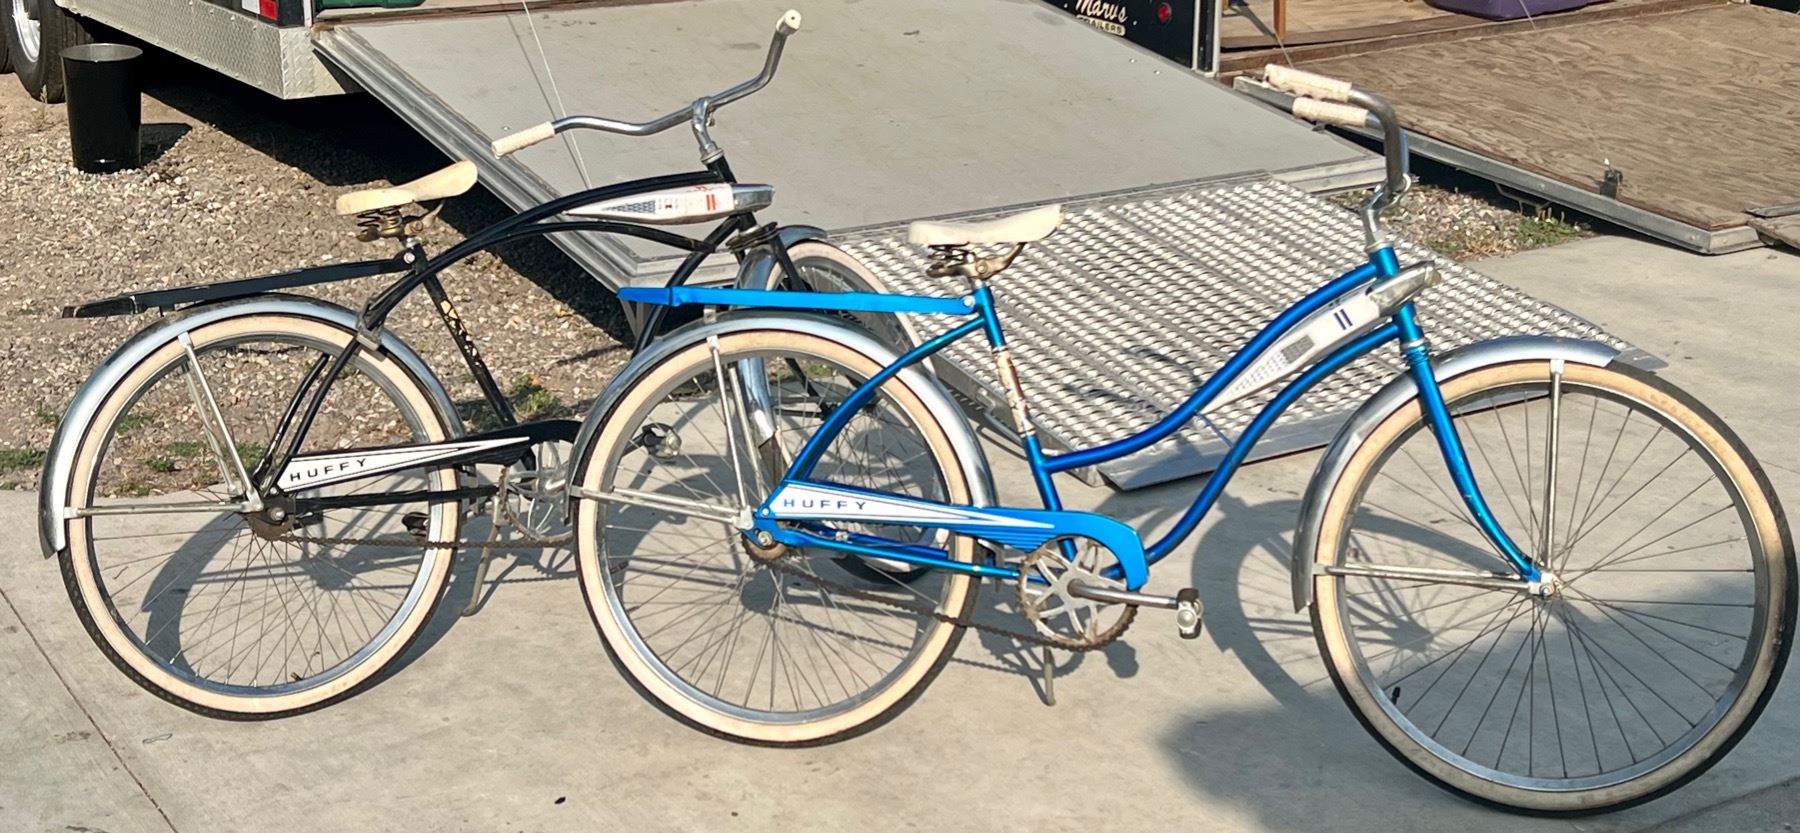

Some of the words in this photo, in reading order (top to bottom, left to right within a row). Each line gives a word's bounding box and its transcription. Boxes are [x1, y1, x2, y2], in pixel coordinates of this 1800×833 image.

[1078, 17, 1123, 34] AILERS
[290, 458, 366, 482] HUFFY
[783, 498, 867, 510] HUFFY
